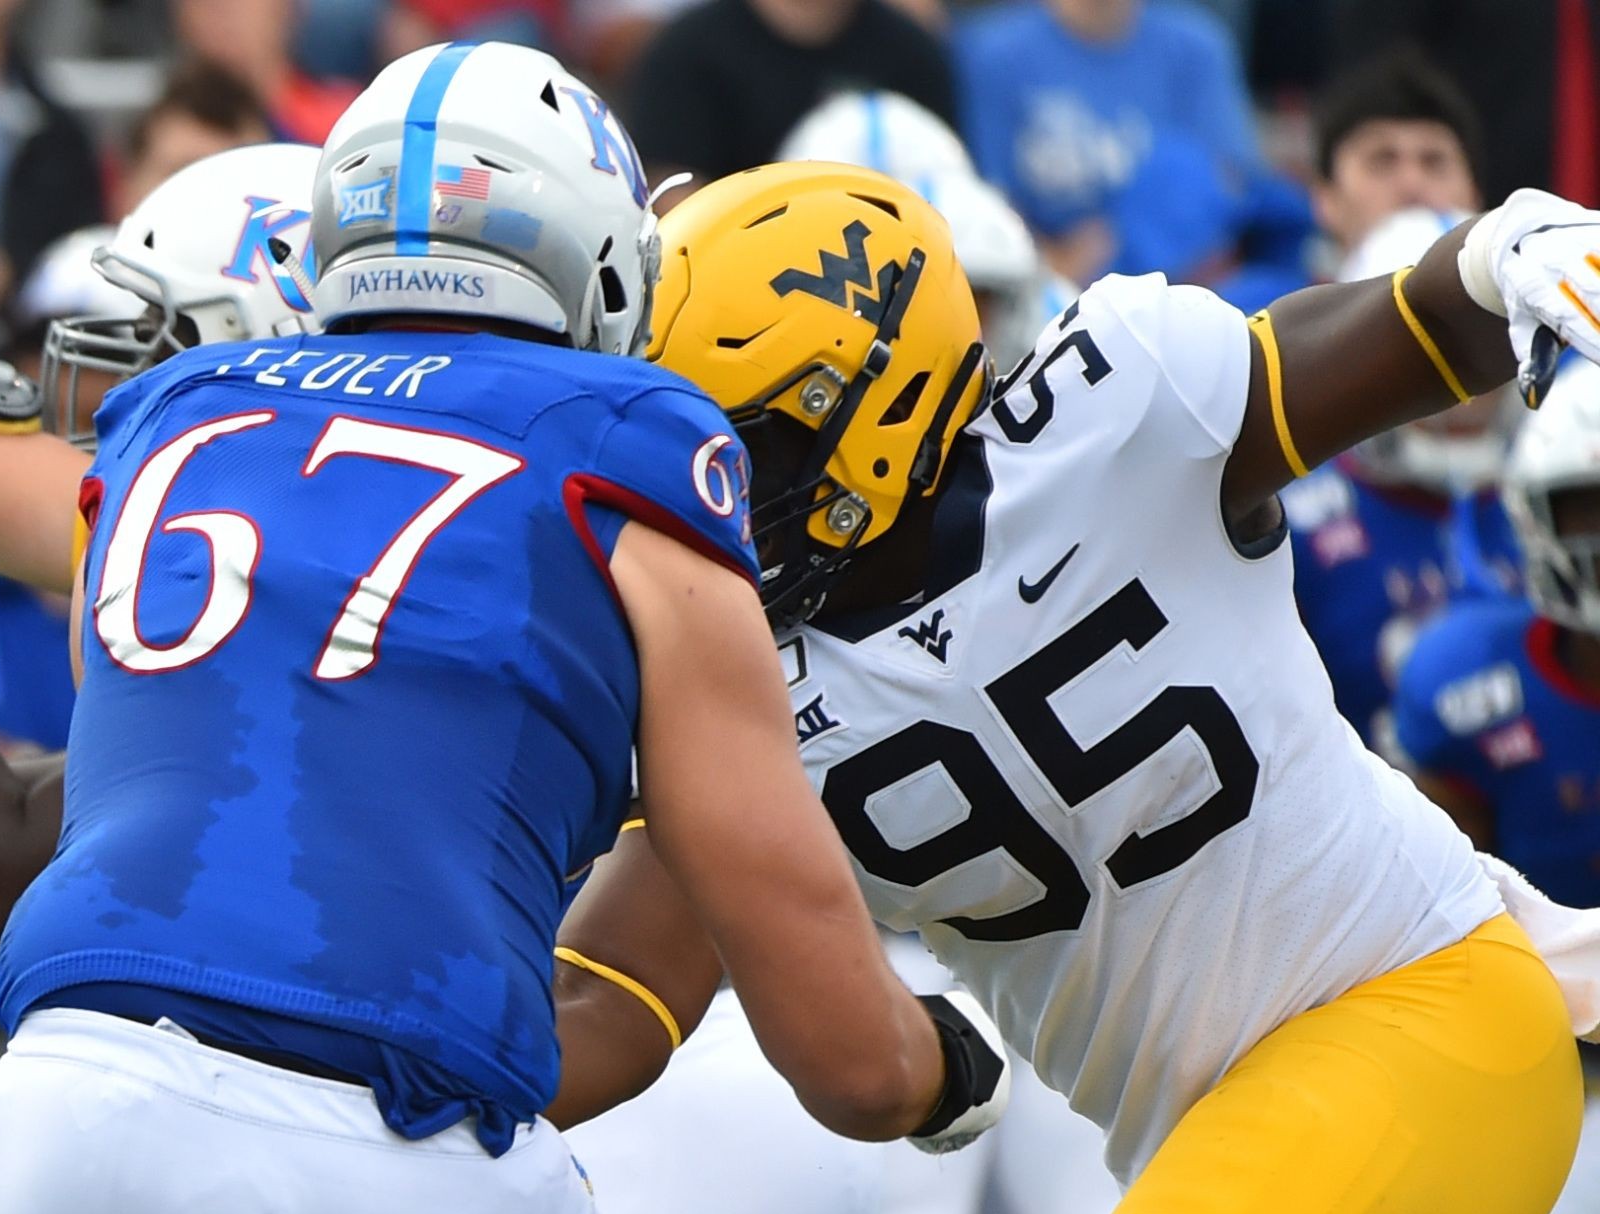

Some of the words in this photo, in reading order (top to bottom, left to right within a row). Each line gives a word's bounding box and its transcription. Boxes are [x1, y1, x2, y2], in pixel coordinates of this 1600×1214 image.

[349, 269, 485, 302] JAYHAWKS
[436, 204, 463, 224] 67
[92, 408, 526, 680] 67
[821, 576, 1260, 943] 95
